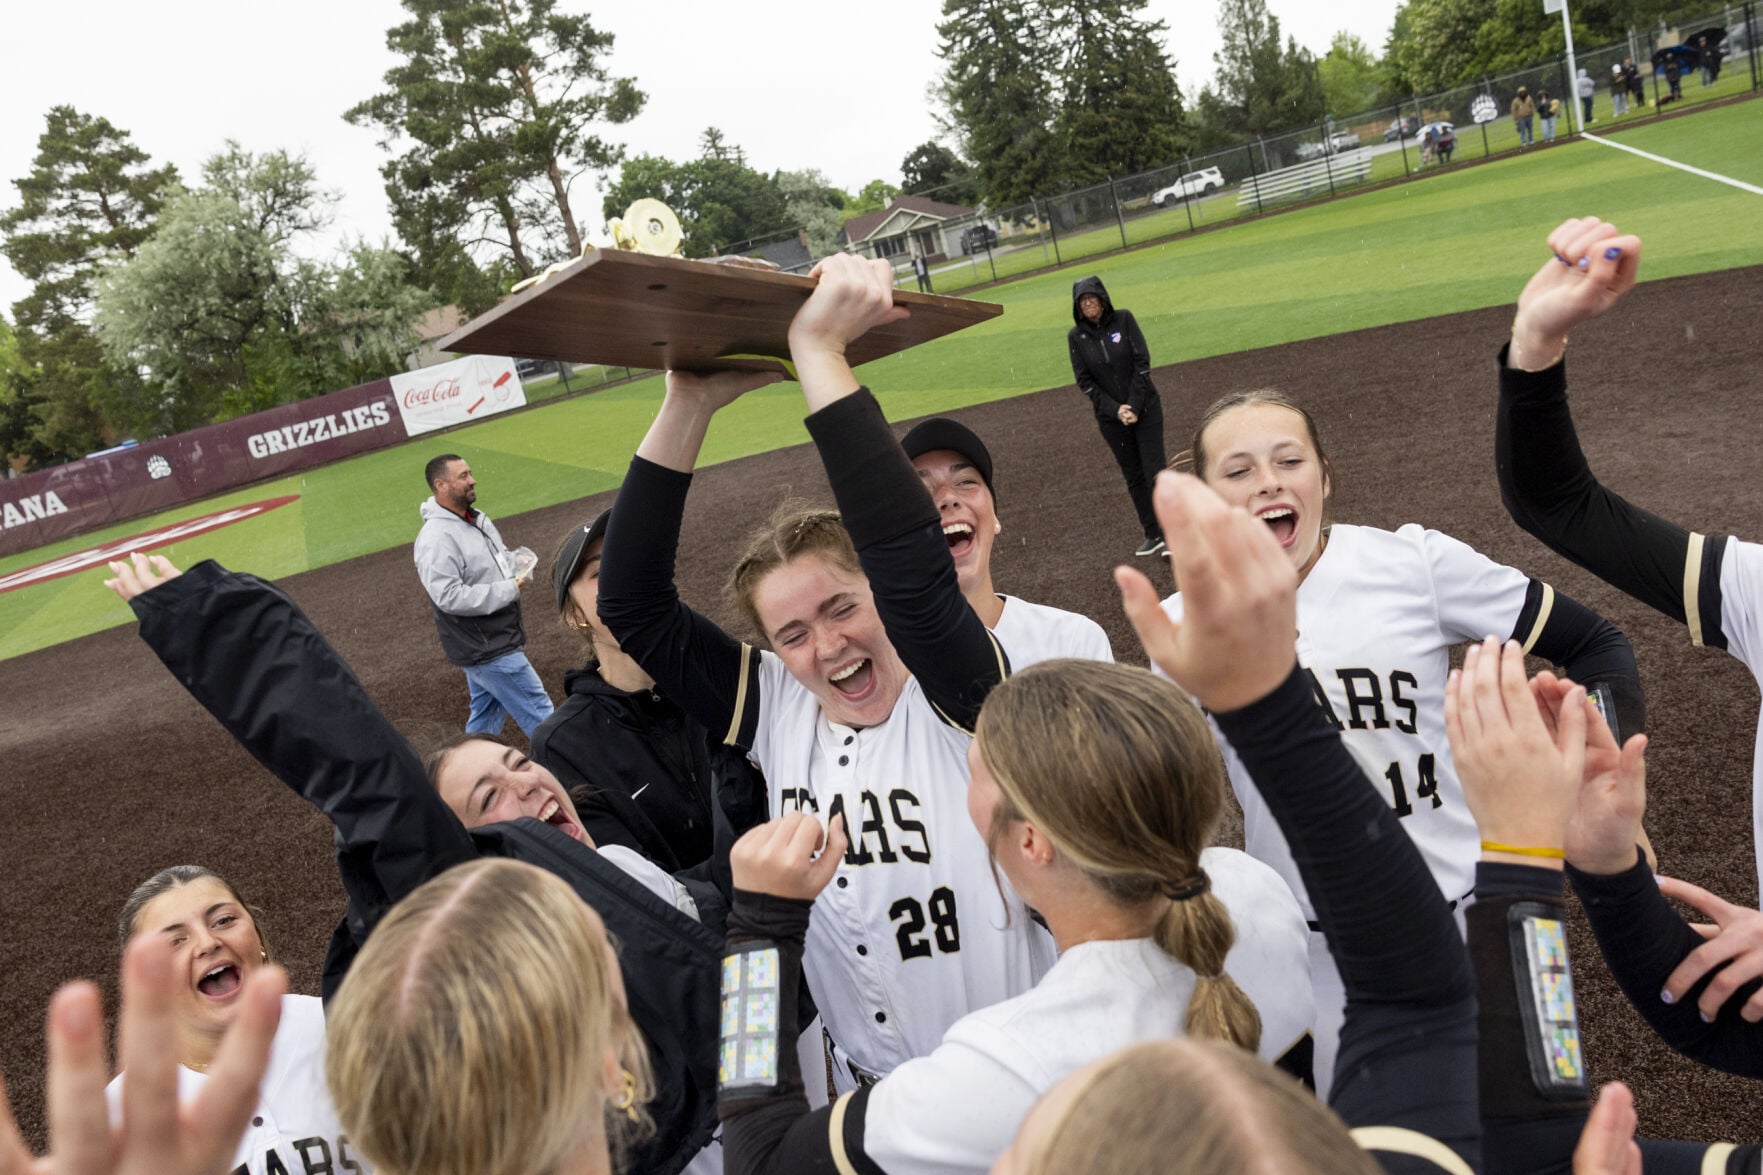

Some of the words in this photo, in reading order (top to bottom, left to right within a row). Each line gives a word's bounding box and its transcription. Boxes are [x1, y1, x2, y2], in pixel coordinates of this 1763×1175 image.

[247, 401, 391, 459] GRIZZLIES
[0, 490, 69, 531] ANA
[1301, 667, 1418, 735] ARS
[1384, 752, 1443, 818] 14
[781, 787, 932, 866] ARS
[888, 886, 961, 962] 28
[231, 1135, 363, 1175] ARS
